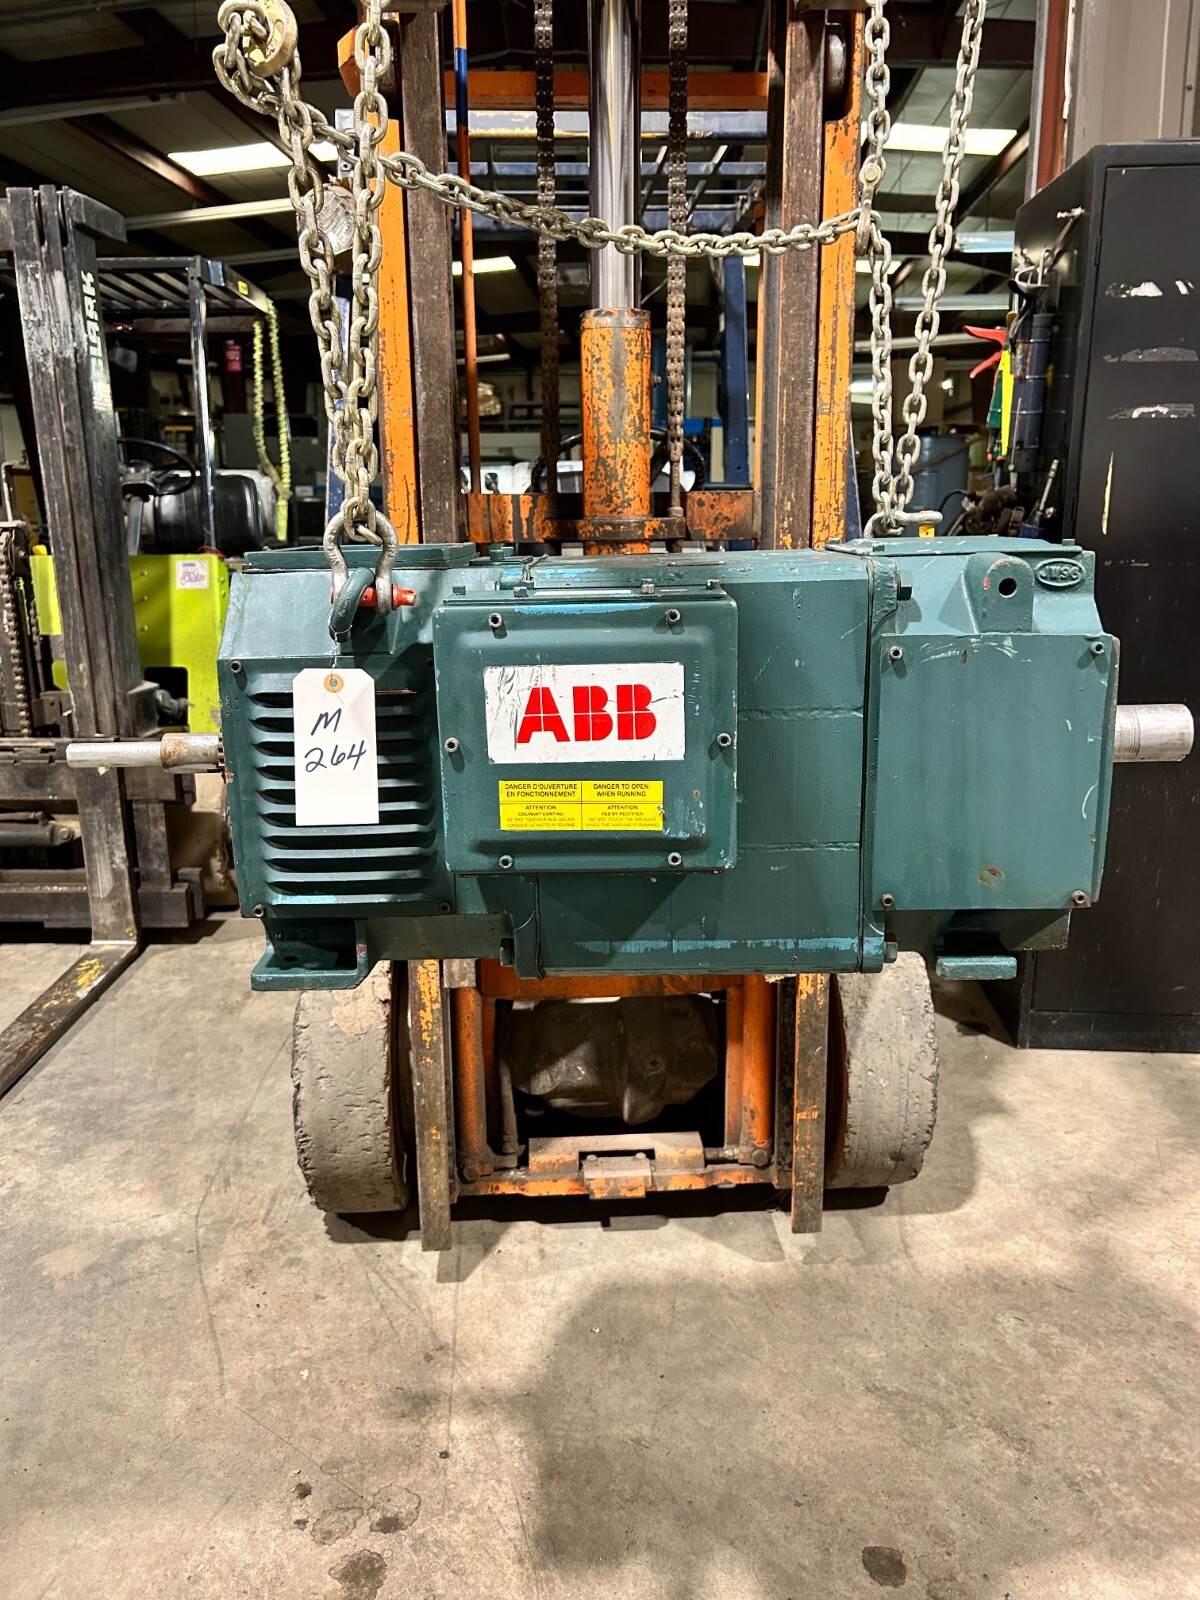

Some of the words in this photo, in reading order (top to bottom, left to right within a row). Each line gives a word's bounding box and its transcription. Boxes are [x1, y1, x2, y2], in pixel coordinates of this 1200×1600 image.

[81, 270, 104, 383] CLARK
[310, 707, 342, 736] M
[516, 684, 657, 744] ABB
[304, 739, 367, 773] 264
